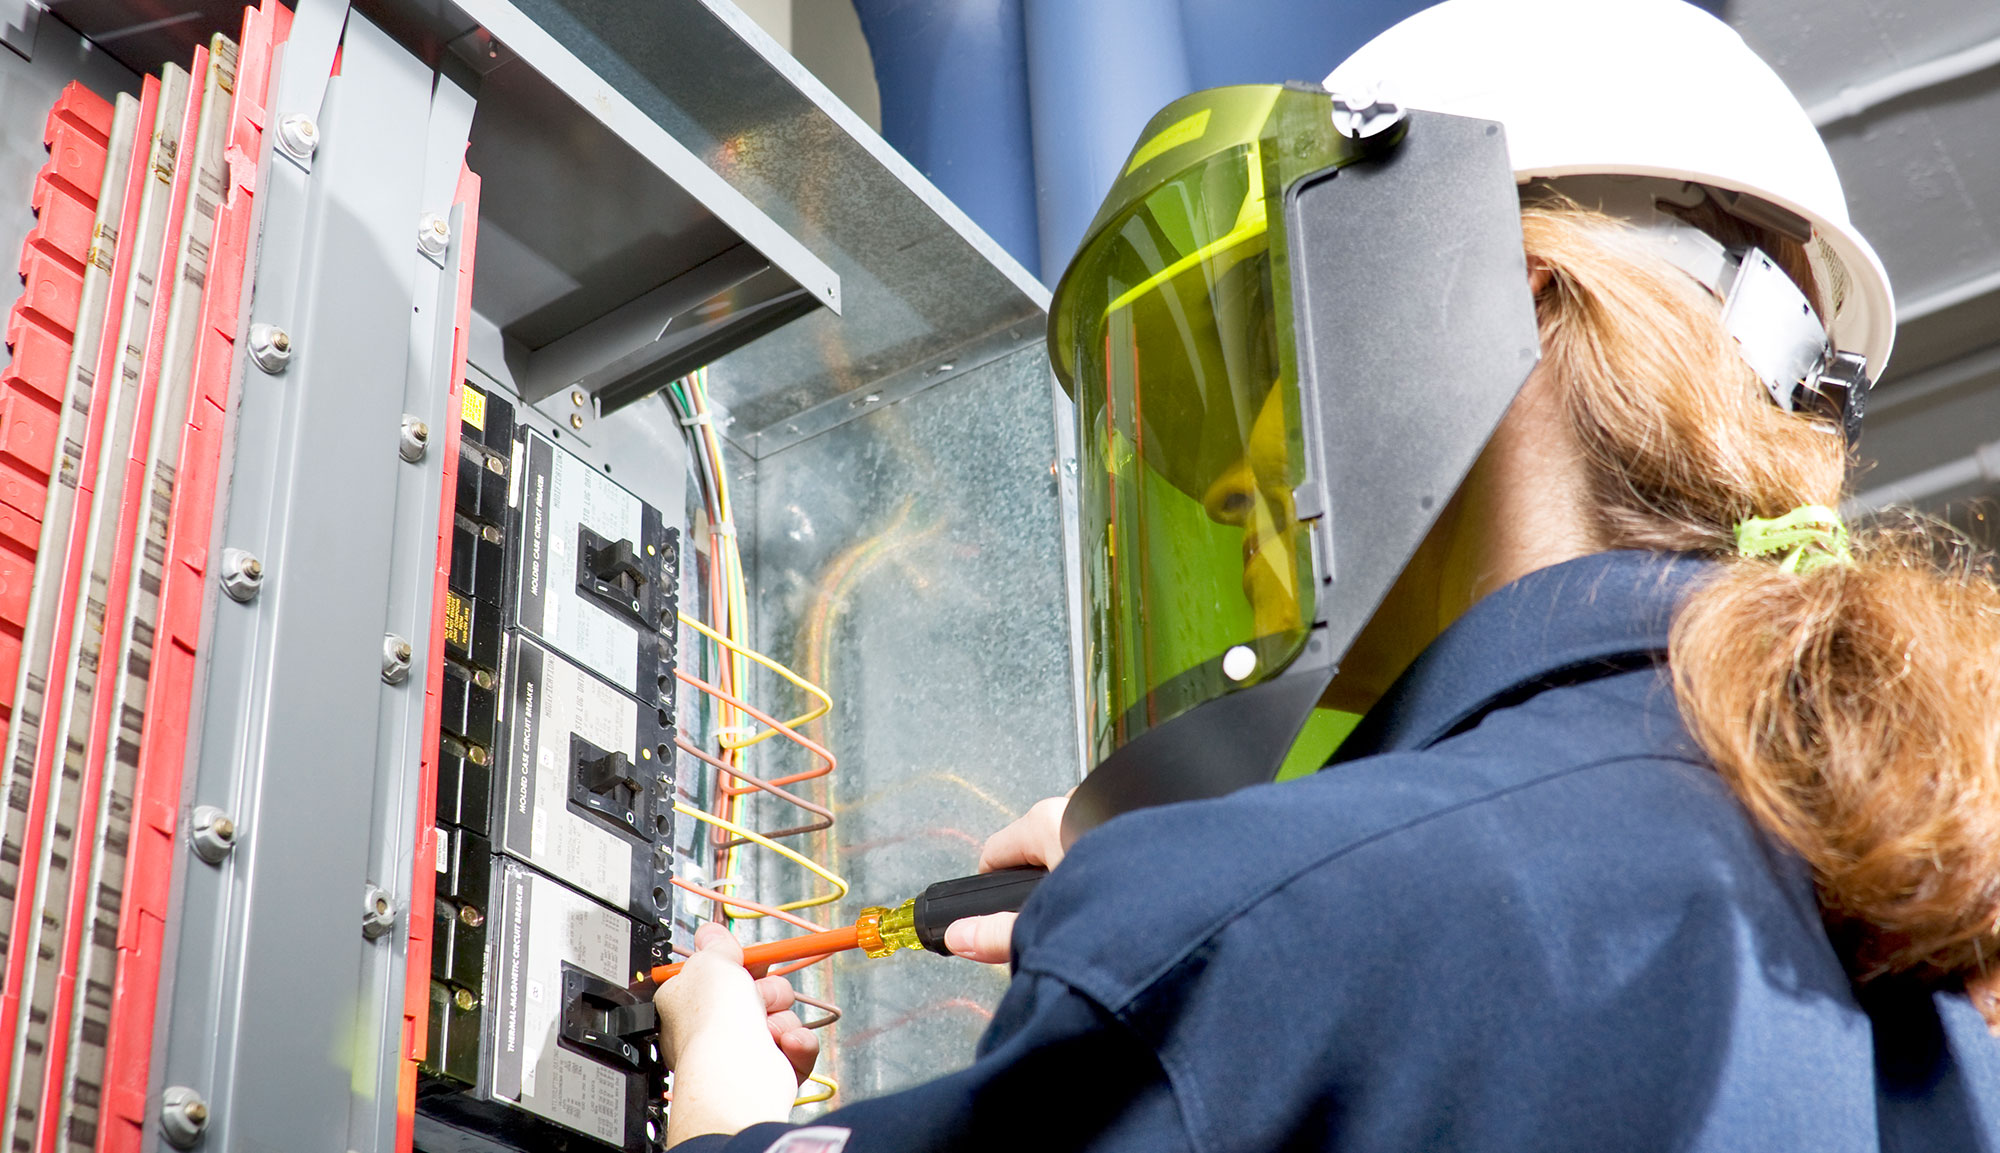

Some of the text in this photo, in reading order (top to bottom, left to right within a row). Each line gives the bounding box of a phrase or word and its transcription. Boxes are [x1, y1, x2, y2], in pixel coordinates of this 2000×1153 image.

[530, 474, 544, 596] MOLDED CASE CIRCUIT BREAKER
[664, 563, 674, 573] C
[544, 654, 555, 718] MODIFICATIONS
[576, 671, 586, 693] DATA
[519, 681, 534, 814] MOLDED CASE CIRCUIT BREAKER
[662, 774, 674, 785] C
[661, 843, 672, 855] B
[658, 916, 670, 928] A
[652, 947, 662, 957] C
[506, 883, 524, 1053] THERMAL-MAGNETIC CIRCUIT BREAKER
[647, 1105, 658, 1116] A
